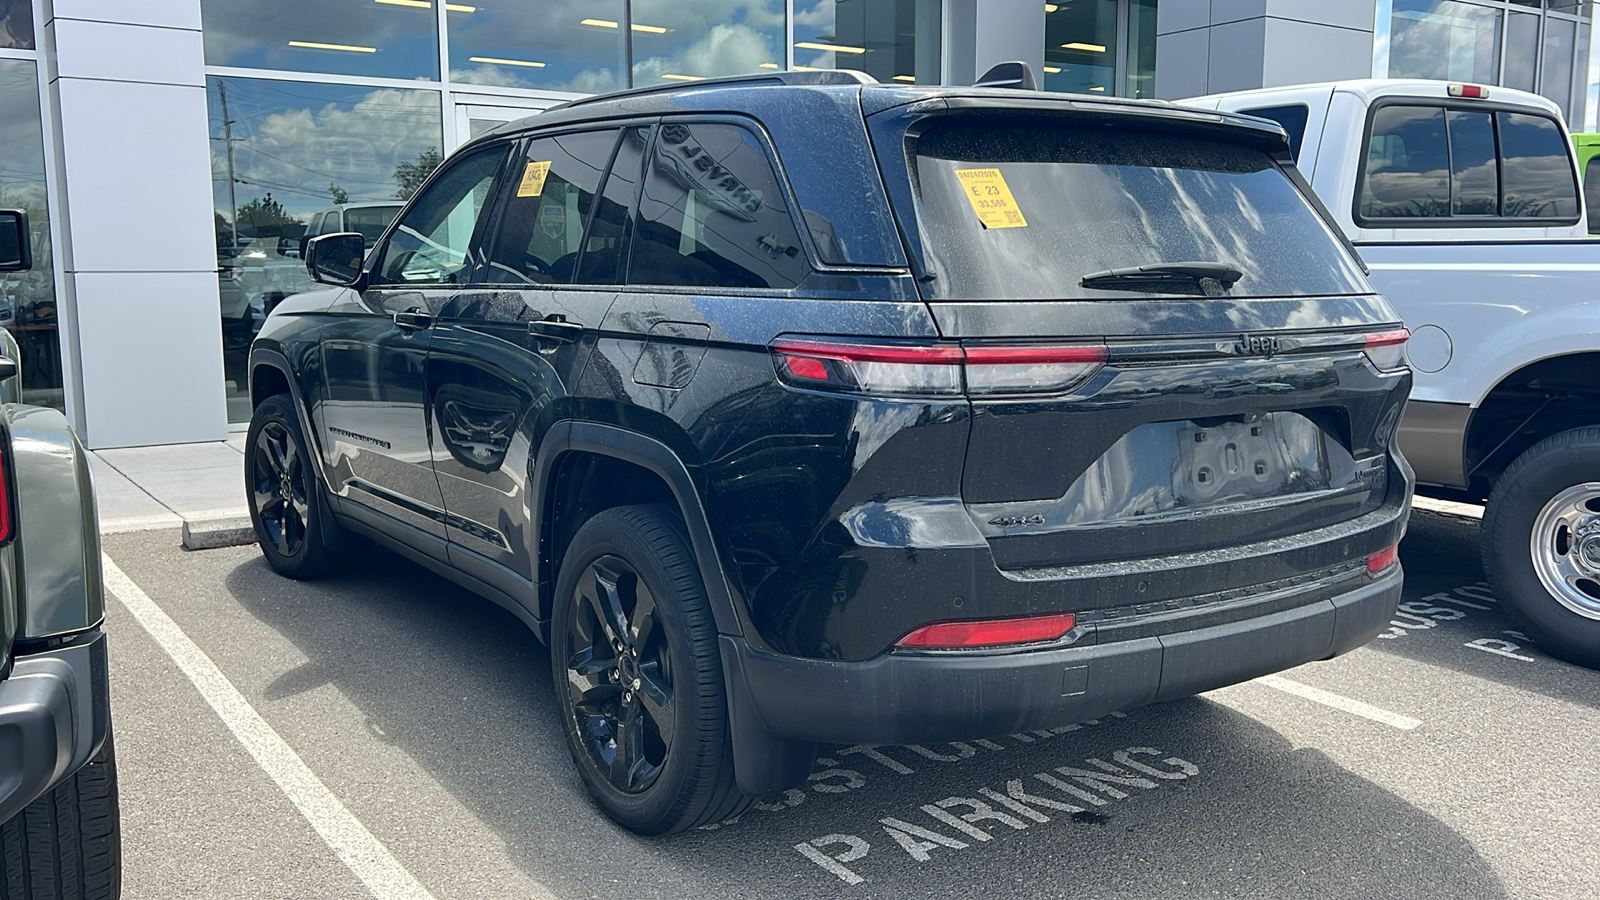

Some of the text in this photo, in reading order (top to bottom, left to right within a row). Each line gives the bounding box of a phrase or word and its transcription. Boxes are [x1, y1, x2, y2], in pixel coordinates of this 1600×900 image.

[971, 185, 1000, 196] E 23
[1233, 333, 1281, 360] Jeep
[794, 745, 1200, 886] PARKING
